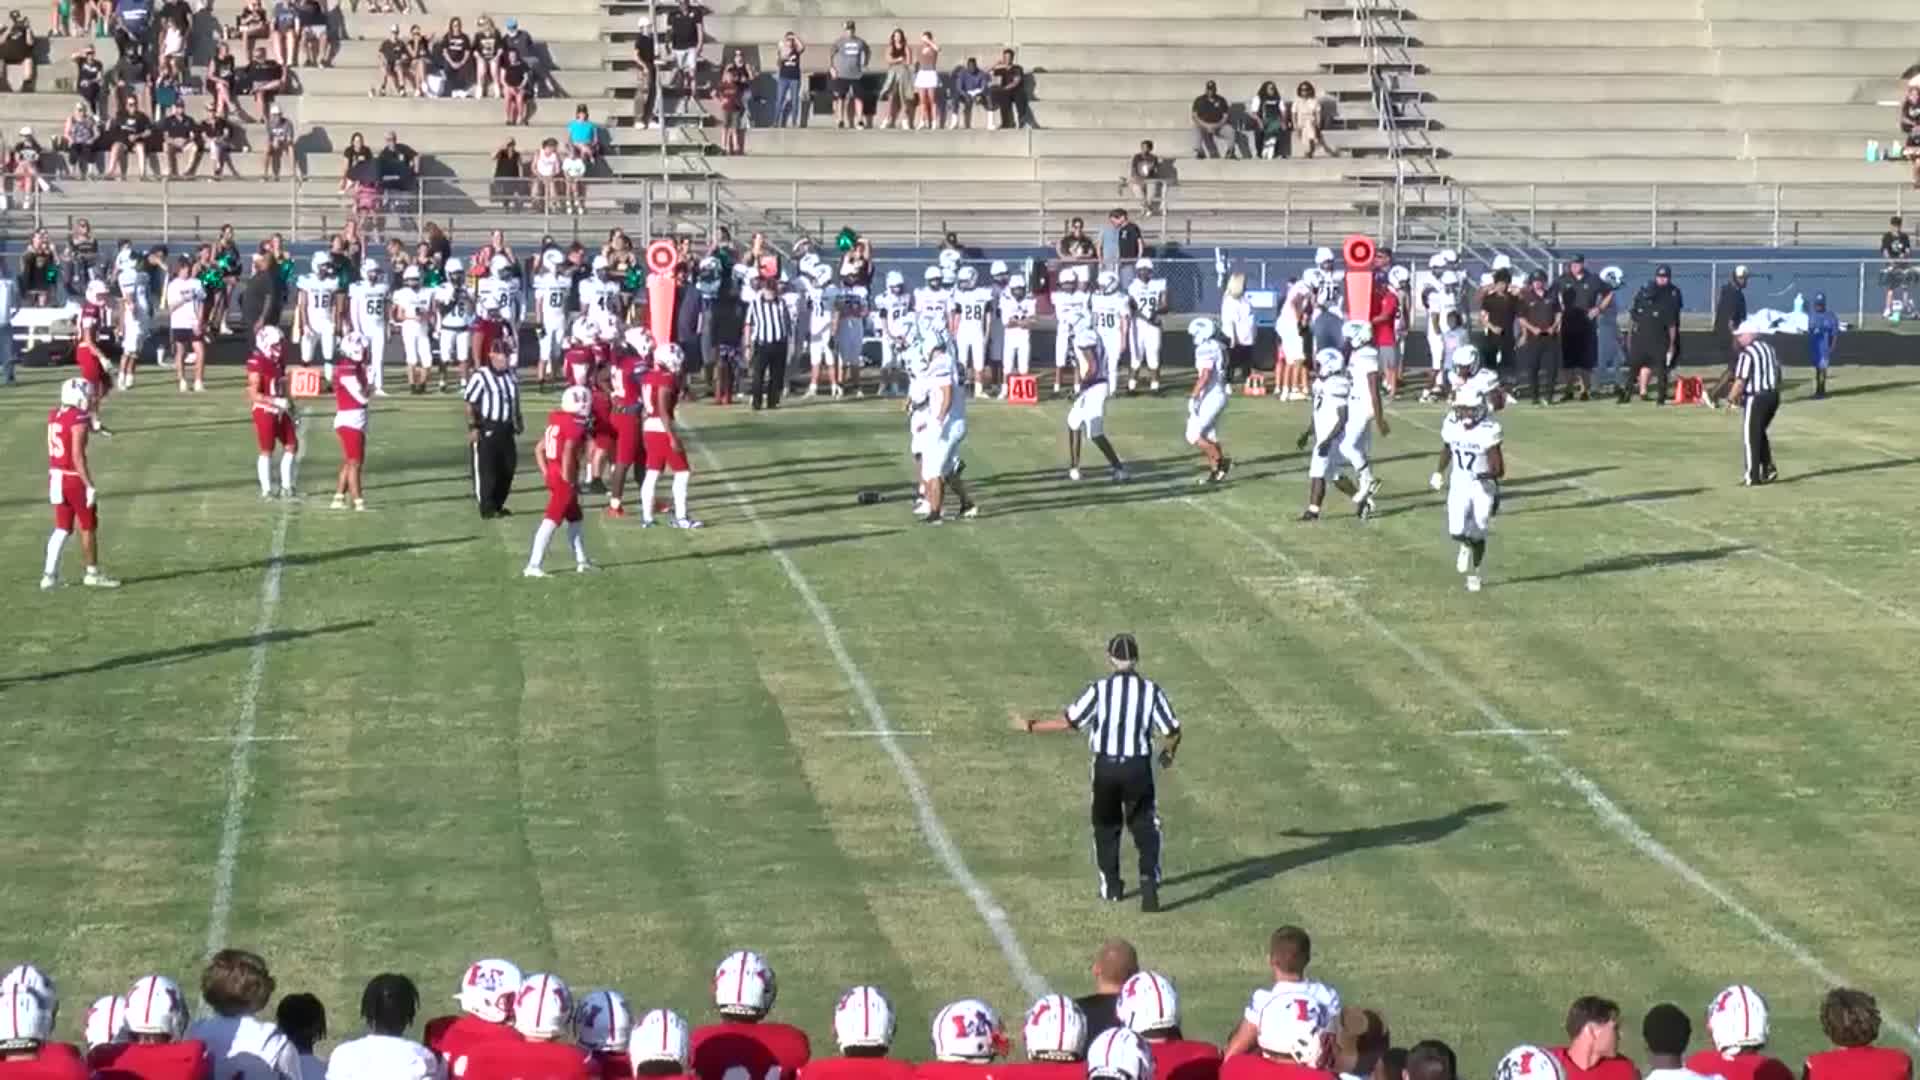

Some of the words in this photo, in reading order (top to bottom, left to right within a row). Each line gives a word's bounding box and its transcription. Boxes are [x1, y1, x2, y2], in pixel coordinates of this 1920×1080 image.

[965, 305, 982, 321] 28
[295, 371, 318, 394] 50
[1012, 379, 1034, 399] 40
[1454, 449, 1477, 471] 17
